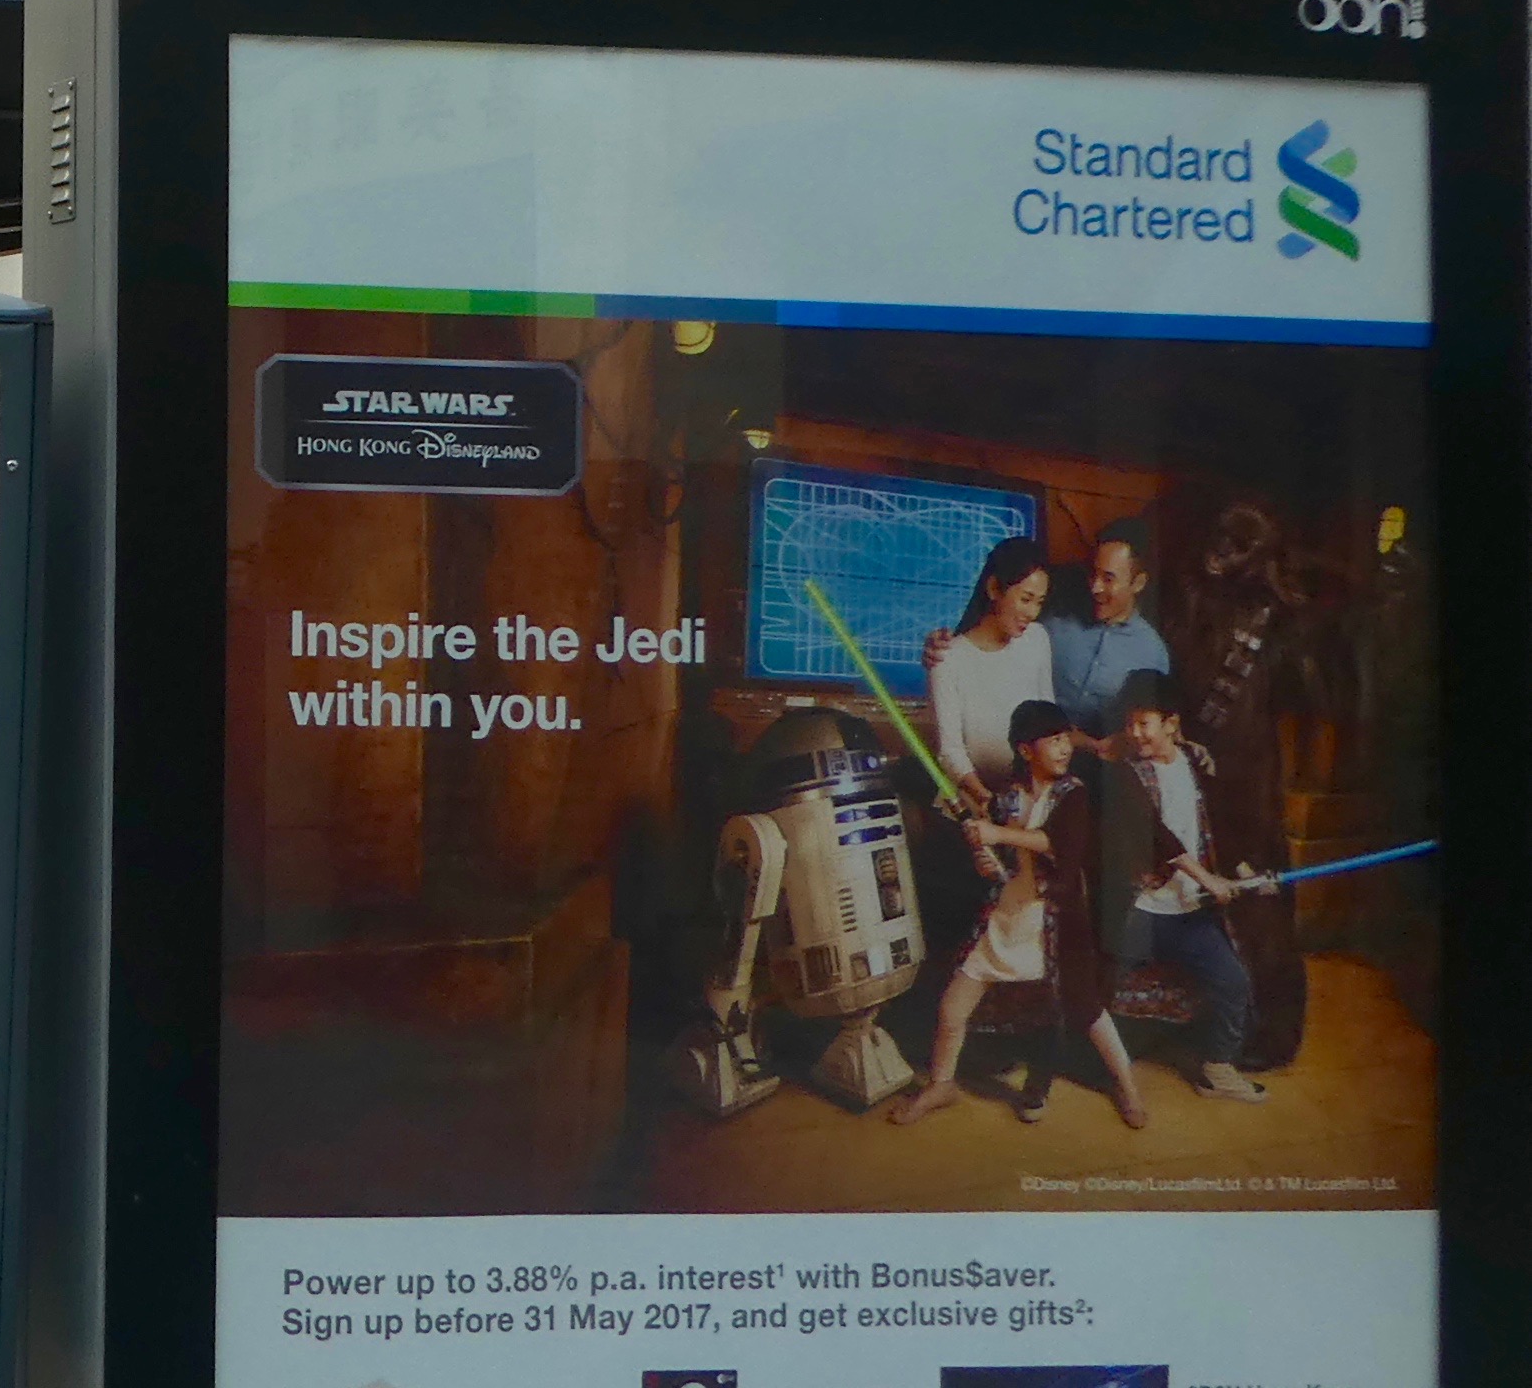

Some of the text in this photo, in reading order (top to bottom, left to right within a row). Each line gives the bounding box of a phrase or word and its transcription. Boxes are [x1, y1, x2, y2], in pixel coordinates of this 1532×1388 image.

[1033, 127, 1253, 184] Standard
[1012, 188, 1255, 244] Chartered
[322, 390, 516, 416] STAR WARS
[290, 610, 706, 669] Inspire the Jedi
[289, 679, 583, 739] within you.
[283, 1268, 386, 1296] Power
[397, 1273, 435, 1301] up
[445, 1268, 476, 1294] to
[486, 1264, 579, 1294] 3.88%
[590, 1270, 647, 1297] p.a.
[795, 1263, 861, 1290] with
[871, 1259, 1056, 1290] Bonus$aver.
[282, 1307, 354, 1342] Sign
[364, 1313, 404, 1341] up
[414, 1307, 515, 1335] before
[524, 1304, 556, 1332] 31
[569, 1303, 635, 1336] May
[643, 1302, 722, 1334] 2017,
[731, 1302, 787, 1329] and
[798, 1302, 848, 1335] get
[856, 1300, 998, 1328] exclusive
